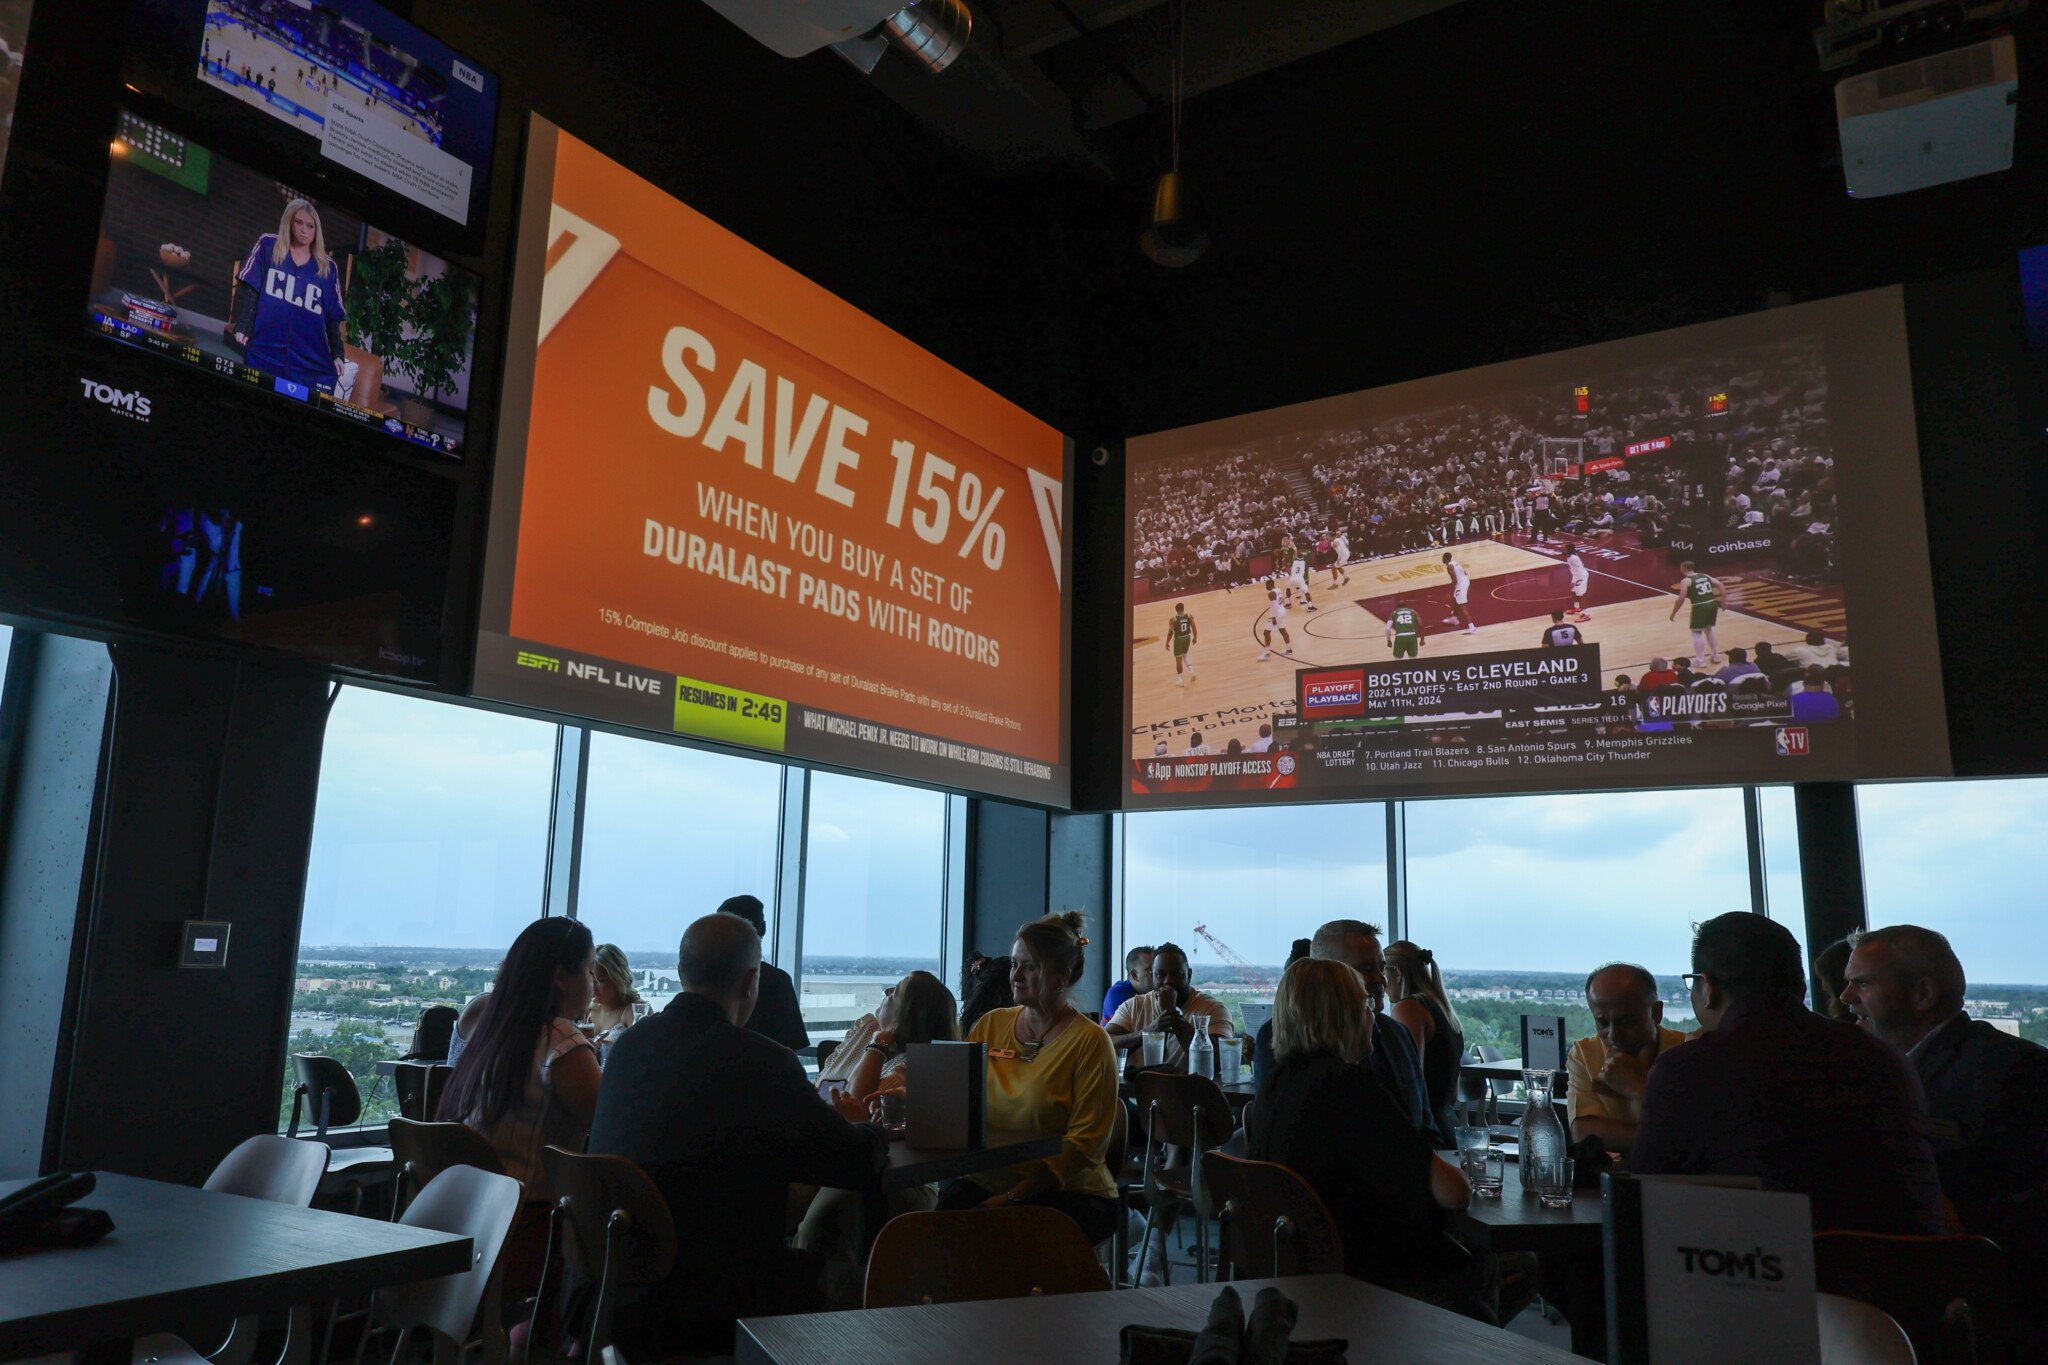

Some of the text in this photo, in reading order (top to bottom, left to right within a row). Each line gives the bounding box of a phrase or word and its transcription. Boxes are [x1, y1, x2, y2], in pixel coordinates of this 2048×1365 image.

[458, 66, 478, 86] NBA
[346, 108, 364, 124] Sports
[265, 268, 322, 315] CLE
[120, 330, 131, 340] SF
[121, 322, 138, 335] LAD
[160, 341, 169, 349] ET
[222, 366, 234, 375] 7.5
[223, 359, 234, 369] 7.5
[80, 377, 151, 416] TOM'S
[110, 407, 150, 423] WATCH BAR
[647, 326, 1006, 571] SAVE 15%
[697, 482, 973, 614] WHEN YOU BUY A SET OF
[1709, 538, 1771, 554] coinbase
[643, 518, 1000, 668] DURALAST PADS WITH ROTORS
[1695, 582, 1712, 595] 30
[1396, 615, 1412, 624] 42
[516, 651, 661, 695] ESPN NFL LIVE
[600, 608, 622, 627] 15%
[625, 614, 669, 640] Complete
[672, 628, 689, 644] Job
[691, 632, 728, 654] discount
[729, 644, 758, 664] applies
[760, 652, 769, 664] to
[770, 655, 804, 676] purchase
[807, 664, 814, 676] of
[816, 668, 829, 684] any
[830, 672, 842, 685] set
[843, 673, 850, 686] of
[851, 675, 879, 694] Duralast
[880, 682, 899, 699] Brake
[900, 688, 916, 703] Pads
[917, 692, 930, 707] with
[931, 698, 942, 712] any
[943, 700, 952, 713] set
[965, 706, 987, 722] Duralast
[1369, 658, 1579, 688] BOSTON VS CLEVELAND
[1312, 683, 1355, 694] PLAYOFF
[1368, 688, 1391, 699] 2024
[1394, 684, 1446, 697] PLAYOFFS
[1582, 673, 1588, 684] 3
[680, 684, 781, 724] RESUMES IN 2:49
[1308, 693, 1358, 705] PLAYBACK
[1418, 695, 1442, 706] 2024
[1610, 695, 1626, 706] 16
[1662, 692, 1727, 716] PLAYOFFS
[1732, 699, 1787, 711] Google Pixel
[1505, 718, 1566, 729] EAST SEMIS
[1571, 716, 1599, 725] SERIES
[1602, 715, 1619, 723] TIED
[804, 710, 1051, 780] WHAT MICHAEL PENIX JR. NEEDS TO WORK ON WHILE KIRK COUSINS IS STILL REHABBING
[1365, 736, 1692, 759] 7. Portland Trail Blazers 8. San Antonio Spurs 9. Memphis Grizzlies
[1789, 733, 1805, 750] TV
[1332, 750, 1355, 758] DRAFT
[1366, 750, 1651, 771] 10. Utah Jazz 11. Chicago Bulls 12. Oklahoma City Thunder
[1155, 760, 1271, 781] App NONSTOP PLAYOFF ACCESS
[1325, 758, 1356, 767] LOTTERY
[1532, 1027, 1554, 1036] TOM'S
[1677, 1246, 1785, 1282] TOM'S
